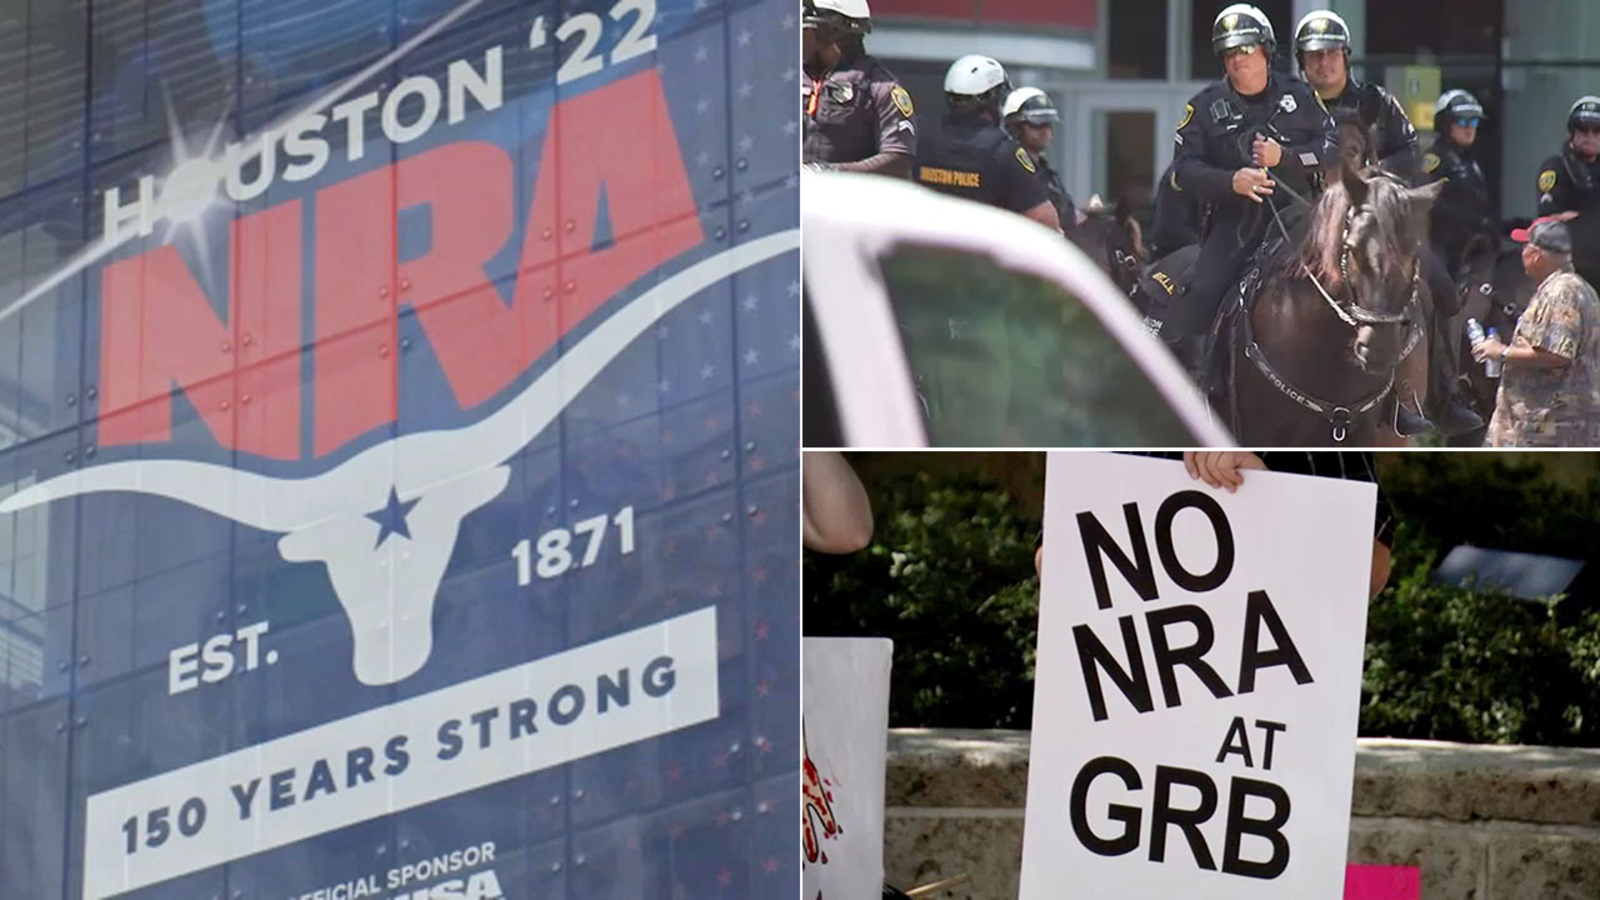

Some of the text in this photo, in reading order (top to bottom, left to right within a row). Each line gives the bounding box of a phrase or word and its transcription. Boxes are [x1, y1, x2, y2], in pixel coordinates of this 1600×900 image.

[952, 170, 980, 187] POLICE
[98, 66, 706, 461] NRA
[1269, 373, 1305, 404] POLICE
[511, 507, 636, 586] 1871
[1076, 490, 1235, 610] NO
[167, 621, 278, 695] EST.
[1072, 590, 1314, 722] NRA
[121, 655, 678, 854] 150 YEARS STRONG
[1215, 716, 1287, 771] AT
[1069, 756, 1291, 880] GRB
[289, 841, 496, 900] FICIAL SPONSOR
